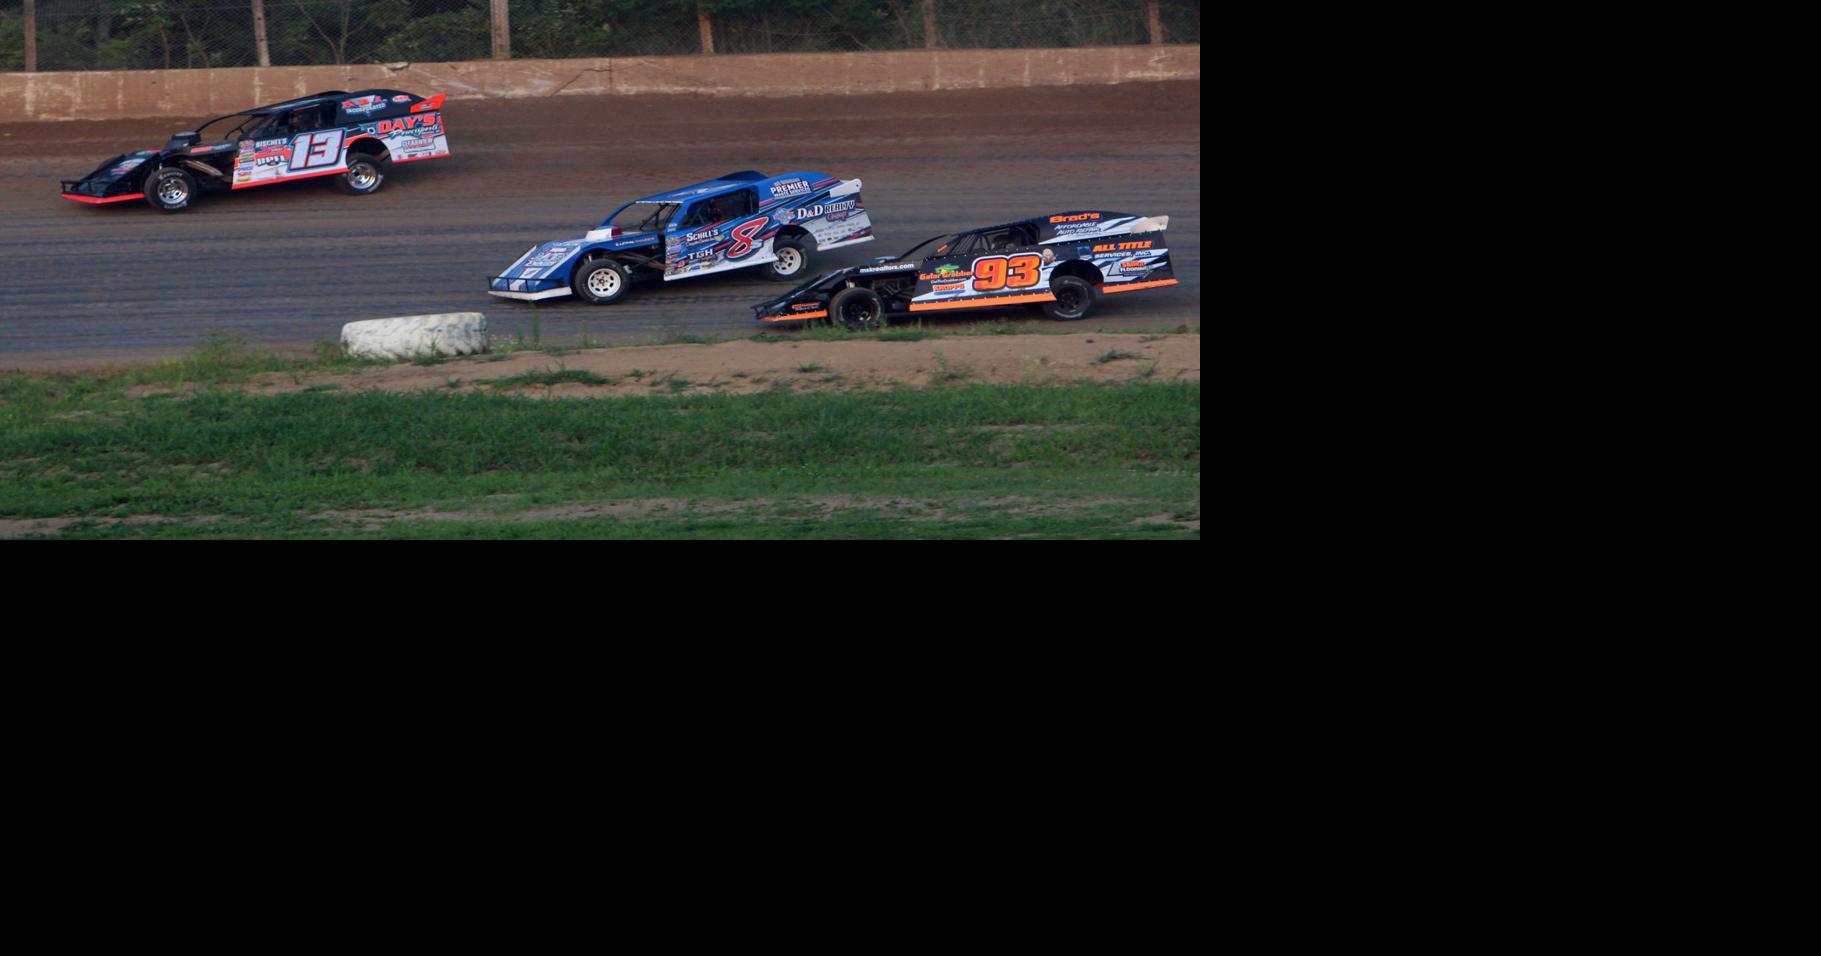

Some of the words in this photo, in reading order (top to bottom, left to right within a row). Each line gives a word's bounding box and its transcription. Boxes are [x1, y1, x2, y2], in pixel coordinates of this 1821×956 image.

[378, 113, 435, 133] DAY'S
[289, 129, 344, 170] 13
[770, 180, 809, 194] PREMIER
[797, 204, 824, 219] D&D
[824, 200, 855, 214] REALTY
[1049, 213, 1100, 223] Brad's
[726, 216, 769, 259] 8
[1093, 244, 1116, 252] ALL
[1118, 240, 1152, 250] TITLE
[687, 248, 714, 260] TGH
[974, 256, 1041, 290] 93
